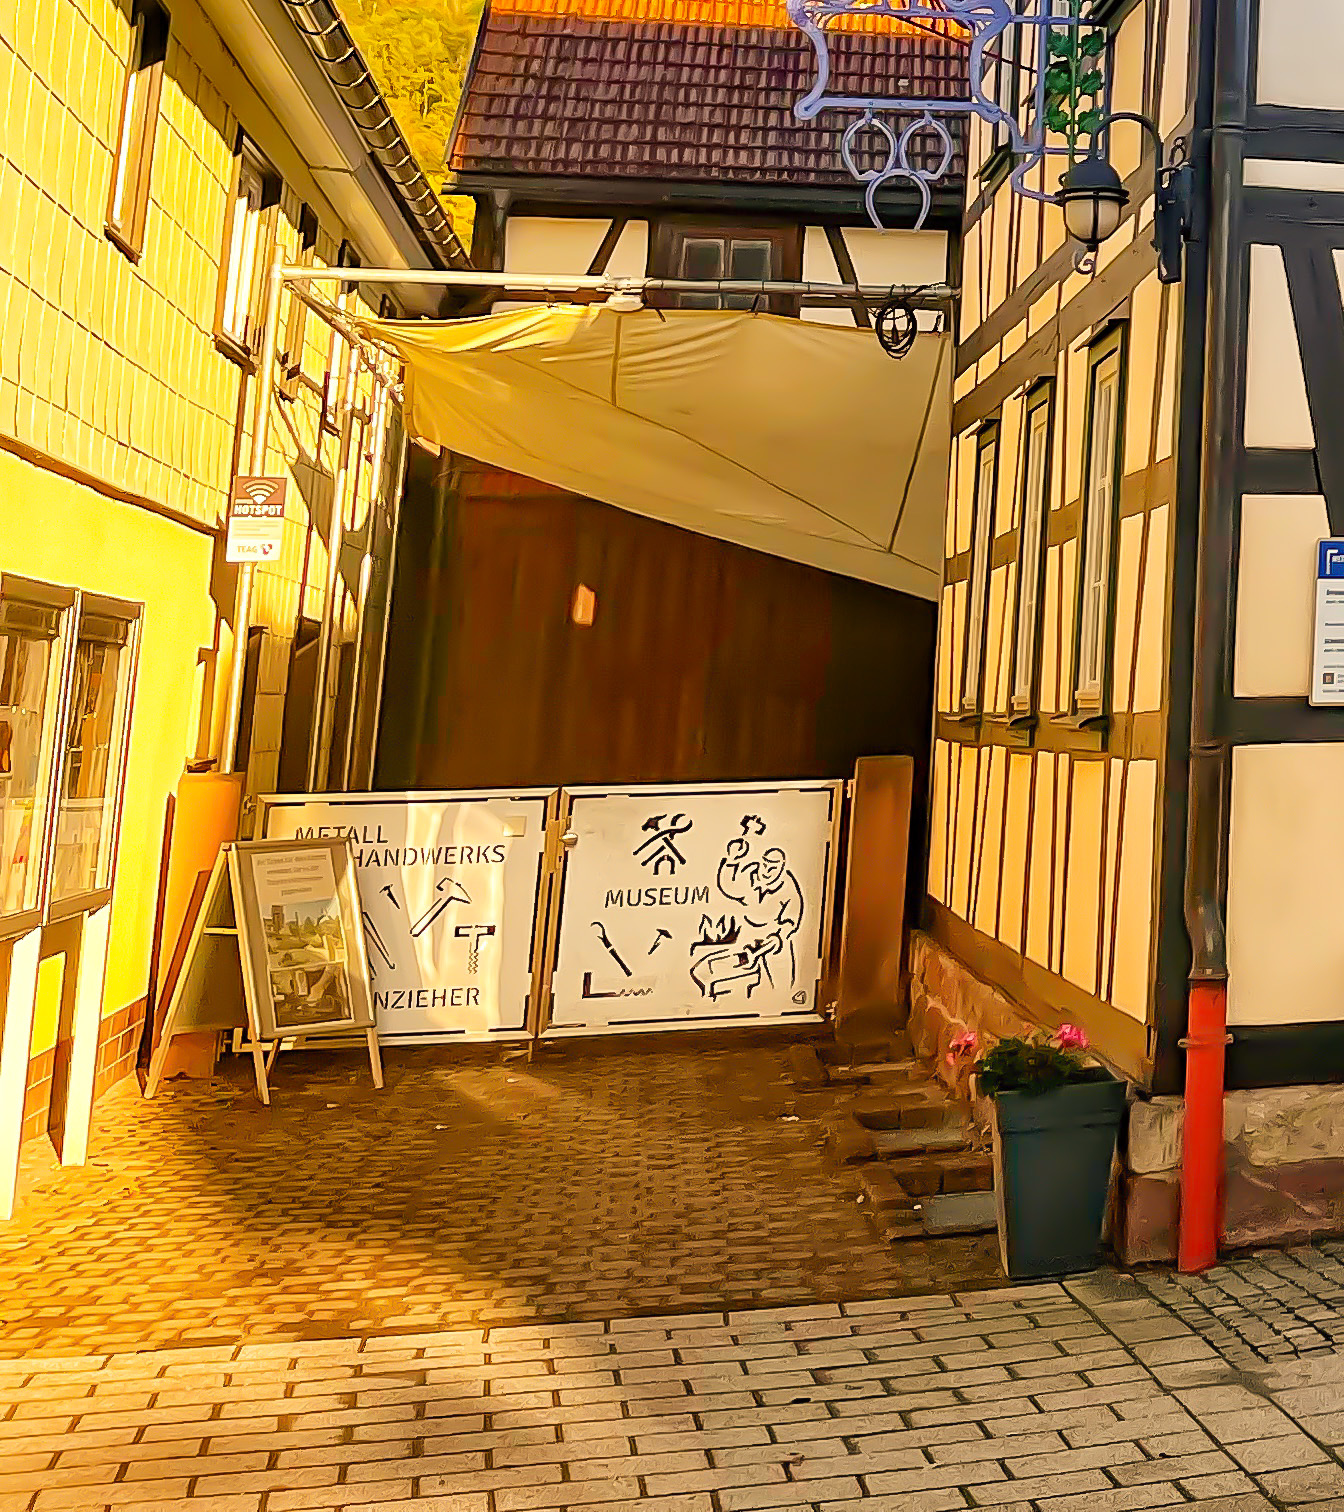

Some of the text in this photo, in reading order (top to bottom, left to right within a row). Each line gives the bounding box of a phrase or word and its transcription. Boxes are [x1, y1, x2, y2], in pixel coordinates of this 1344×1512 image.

[233, 504, 283, 516] HOTSPOT
[237, 545, 258, 553] TEAG
[604, 885, 710, 908] MUSEUM
[373, 987, 480, 1010] NZIEHER
